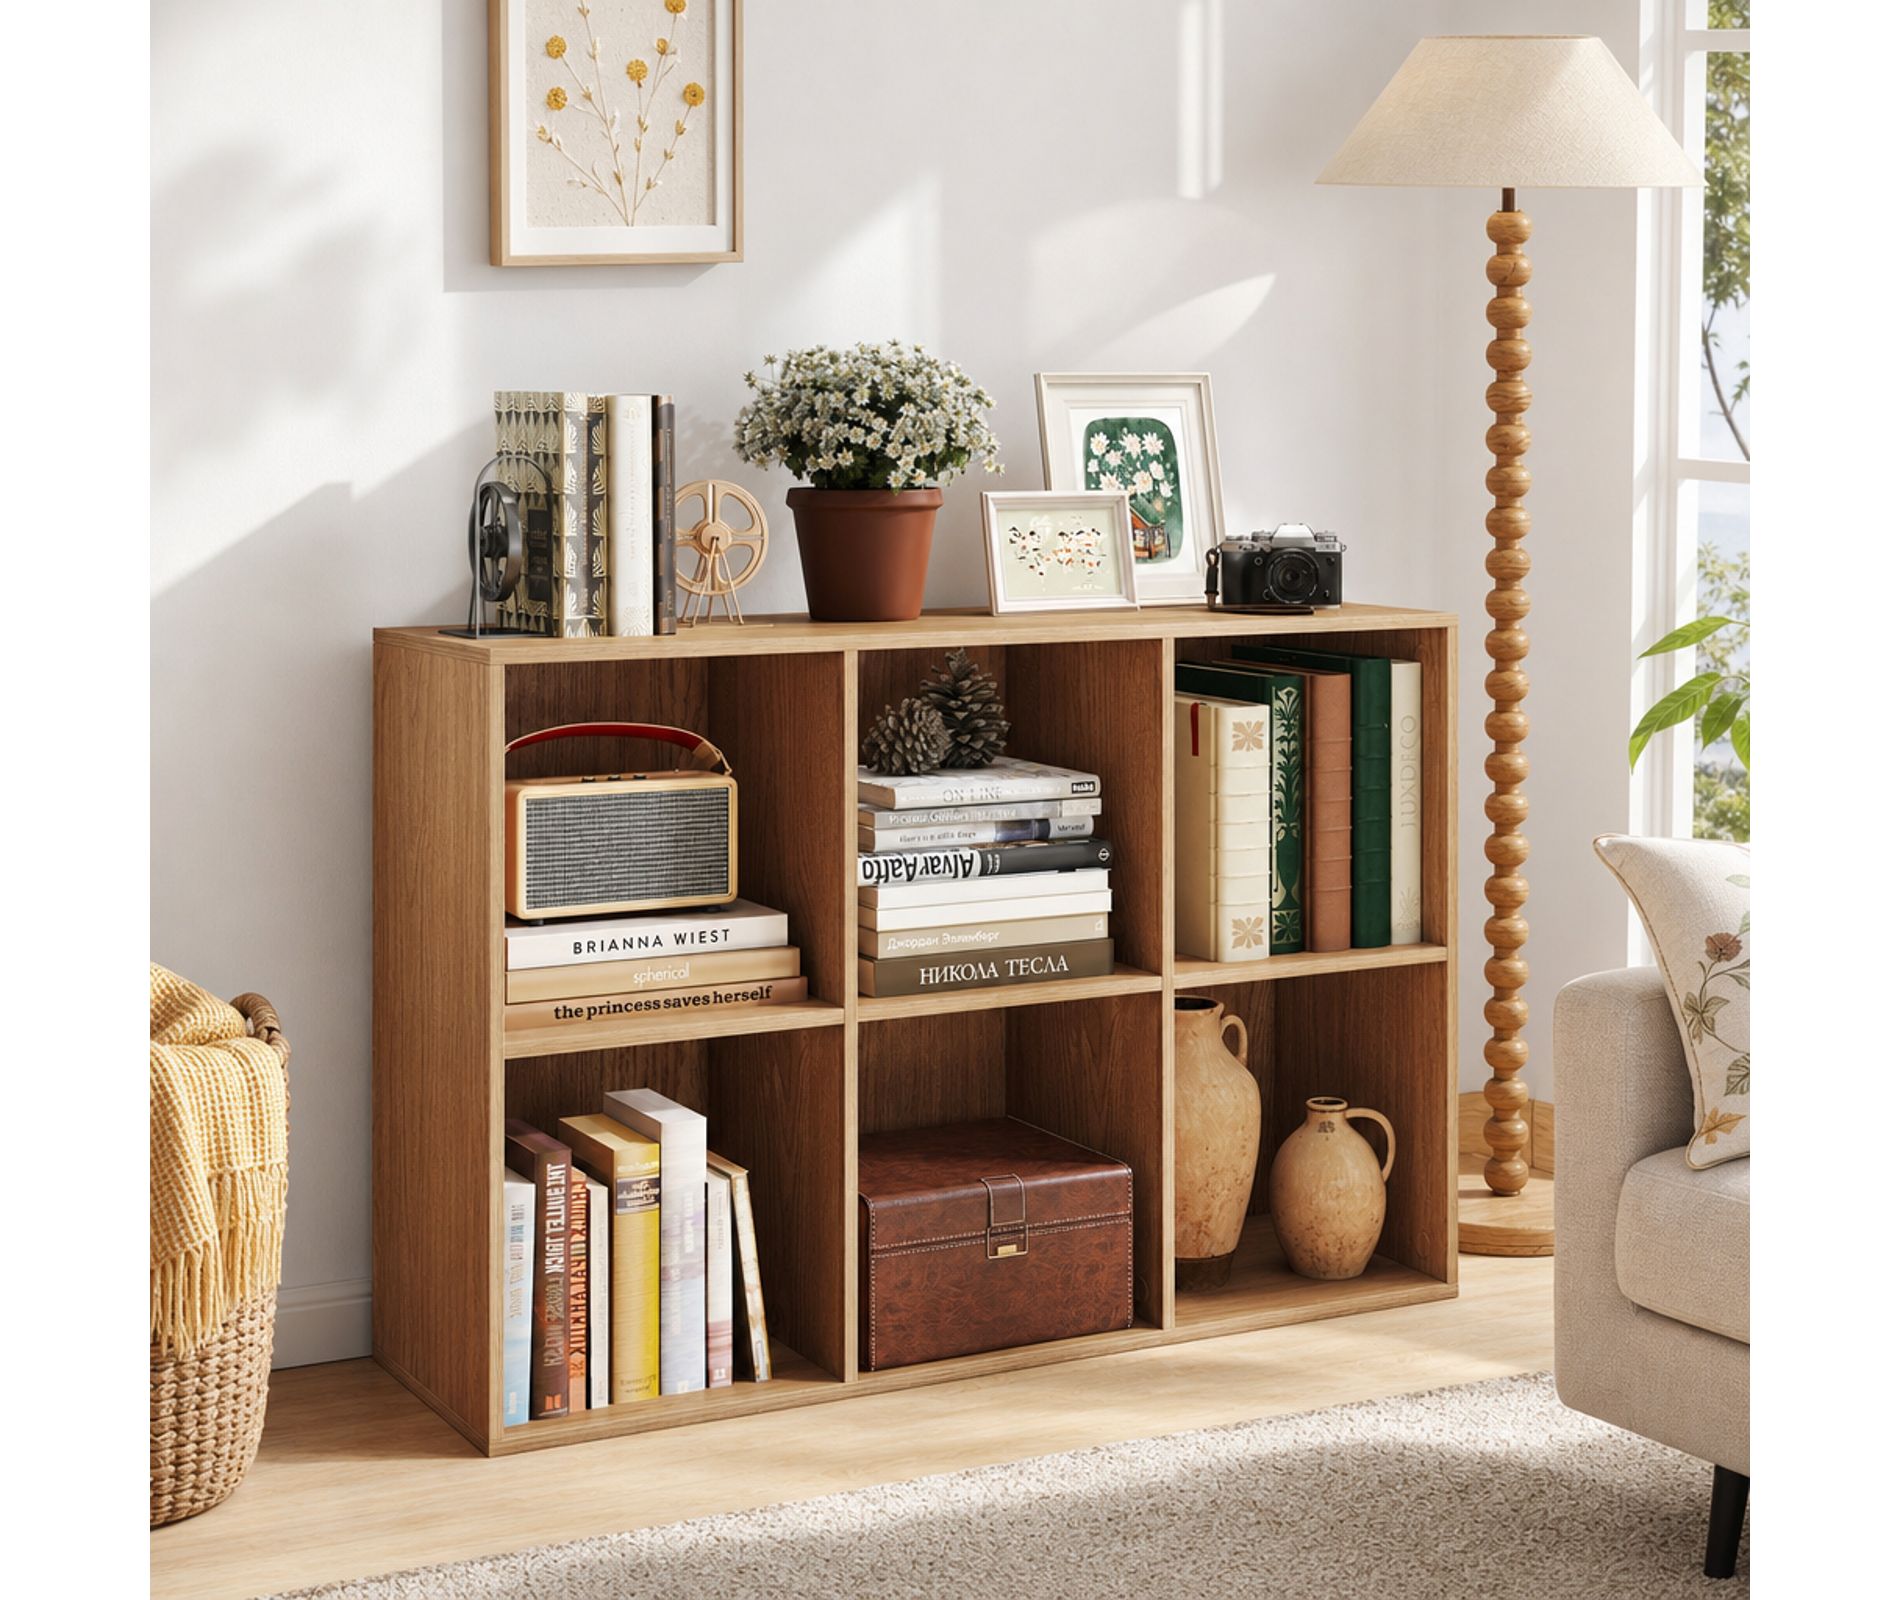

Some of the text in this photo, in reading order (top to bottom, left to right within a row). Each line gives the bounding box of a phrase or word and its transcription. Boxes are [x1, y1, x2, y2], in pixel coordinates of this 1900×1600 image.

[862, 855, 917, 883] Aalto
[919, 853, 974, 879] Alvar
[573, 929, 732, 955] BRIANNA WIEST
[633, 962, 690, 987] spherical
[919, 955, 1069, 985] НИКОЛА ТЕСЛА
[554, 985, 773, 1022] the princess saves herself
